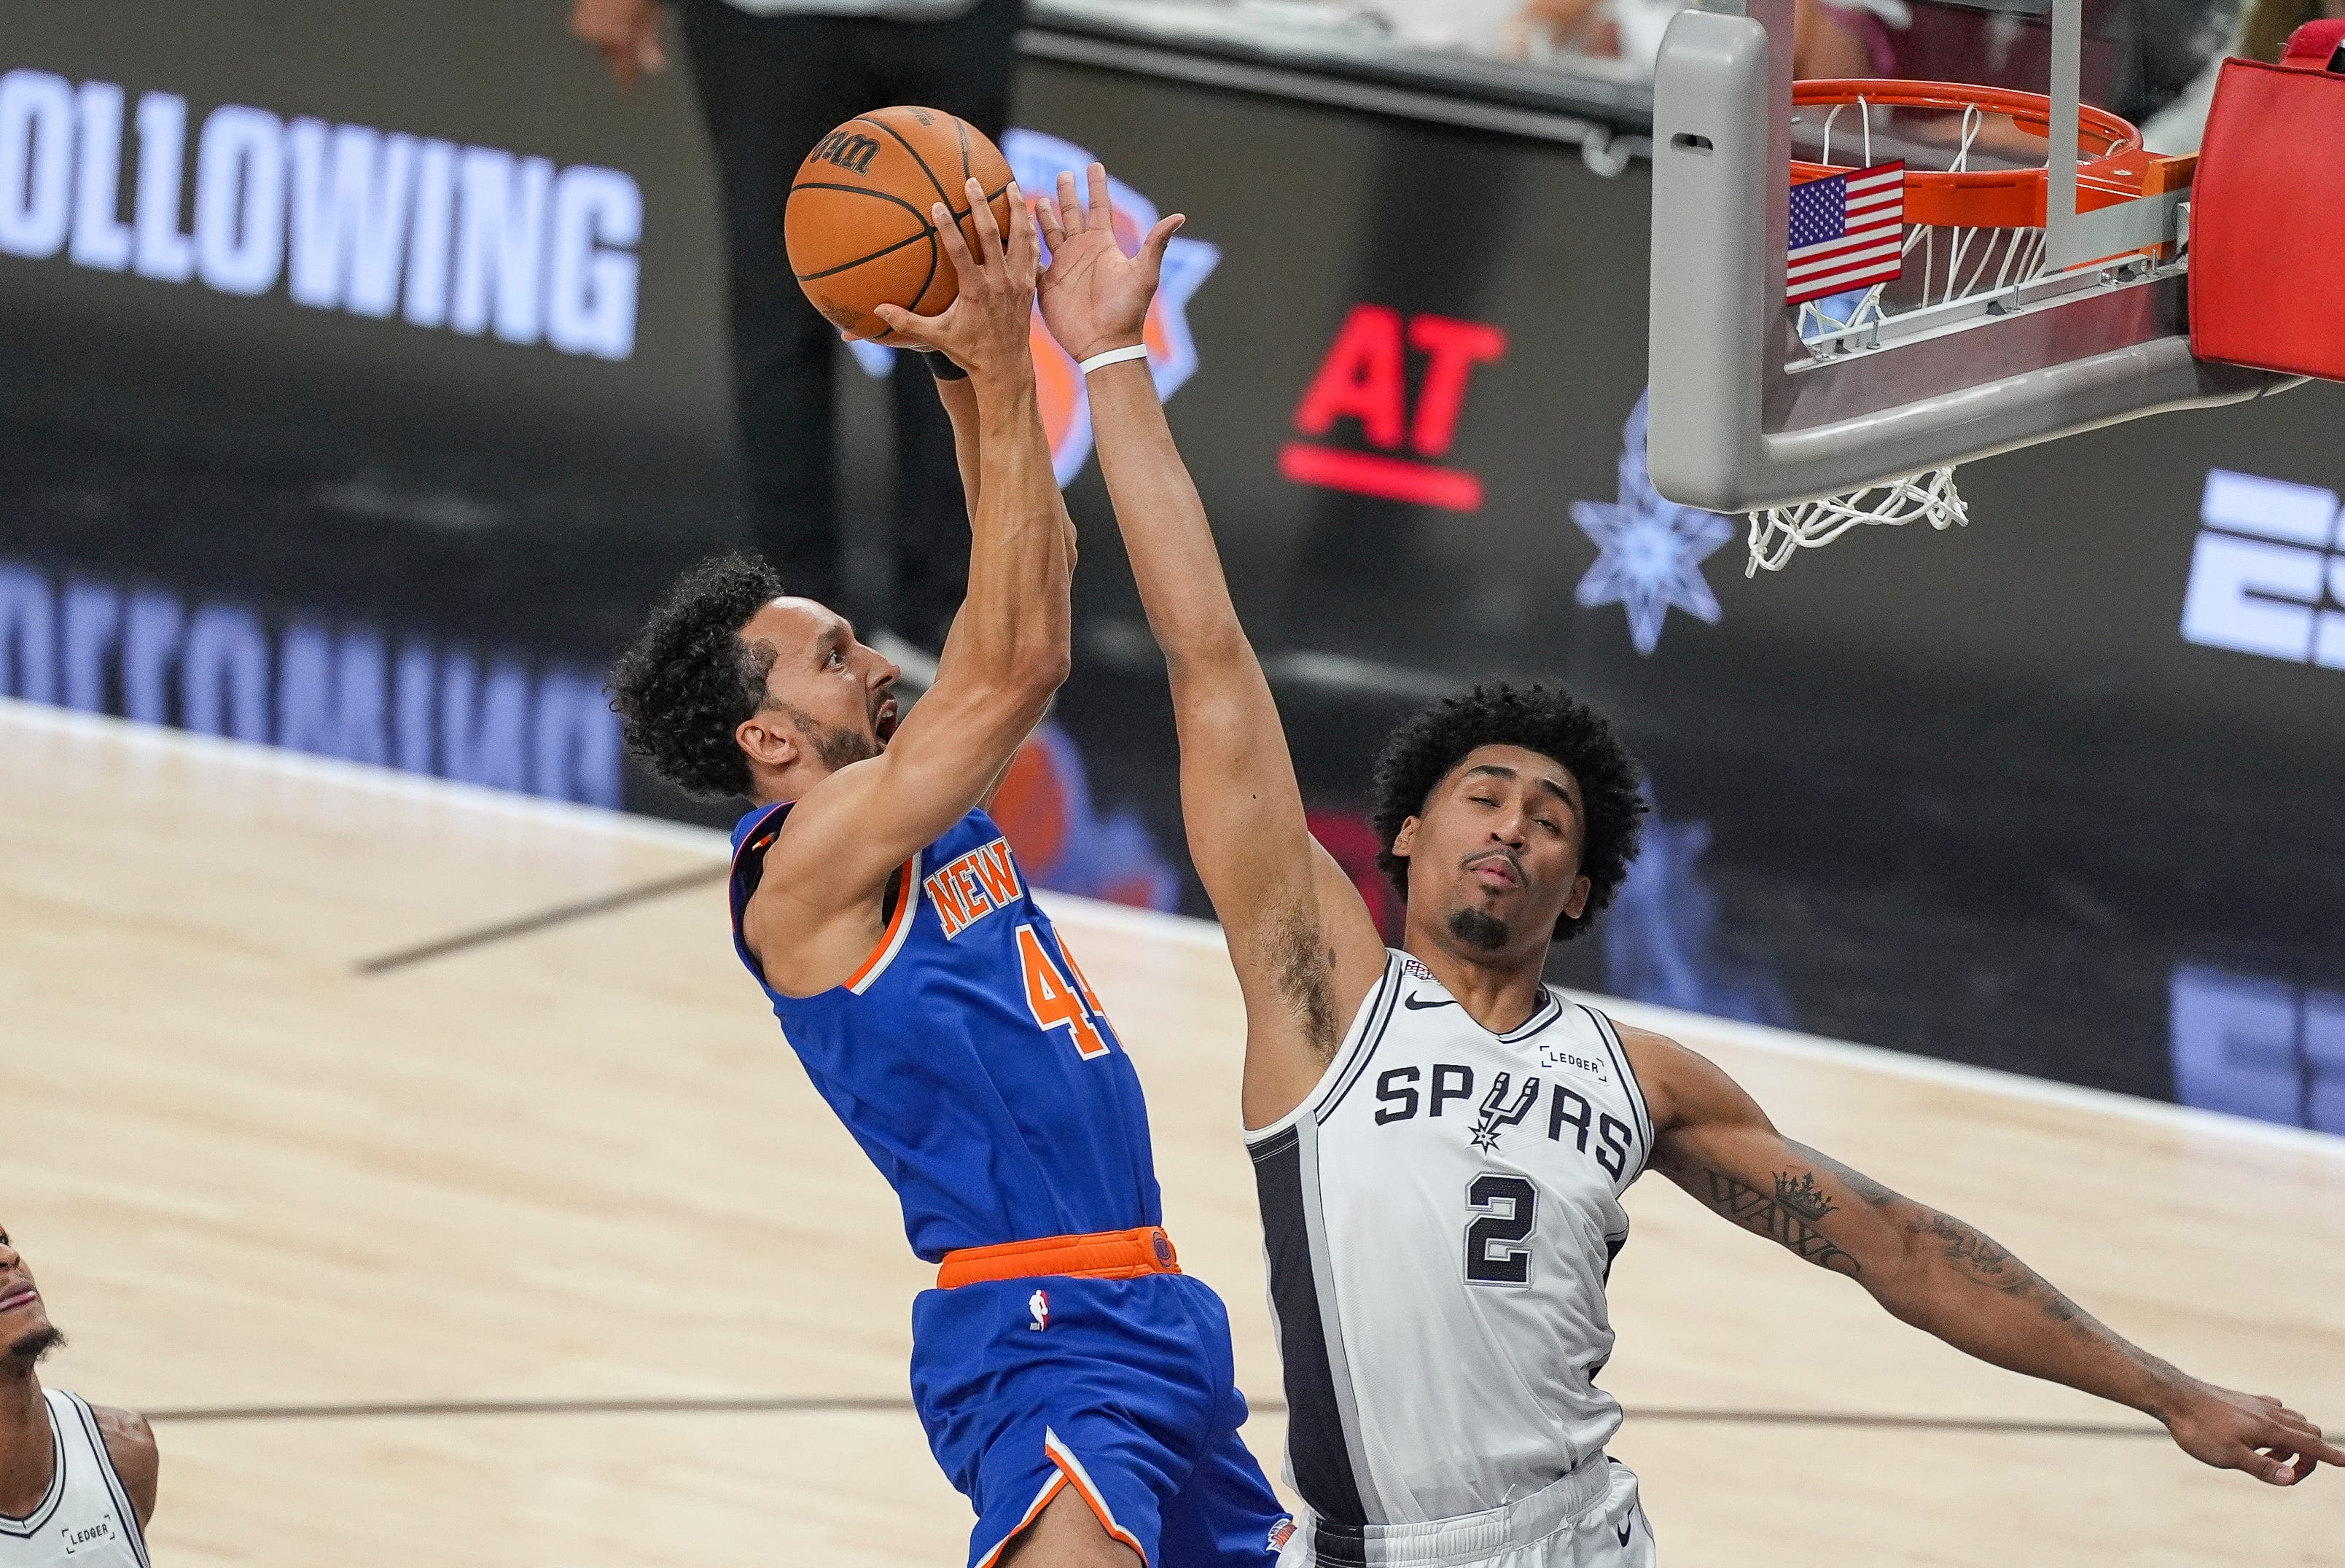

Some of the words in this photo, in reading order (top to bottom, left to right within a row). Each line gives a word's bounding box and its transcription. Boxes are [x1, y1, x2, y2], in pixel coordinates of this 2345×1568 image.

[1292, 302, 1507, 456] AT
[2177, 467, 2345, 671] E
[924, 836, 1023, 940] NEW
[1550, 1052, 1598, 1073] LEDGER
[1375, 1064, 1632, 1182] SPURS
[1464, 1171, 1540, 1288] 2
[70, 1524, 108, 1545] LEDGER
